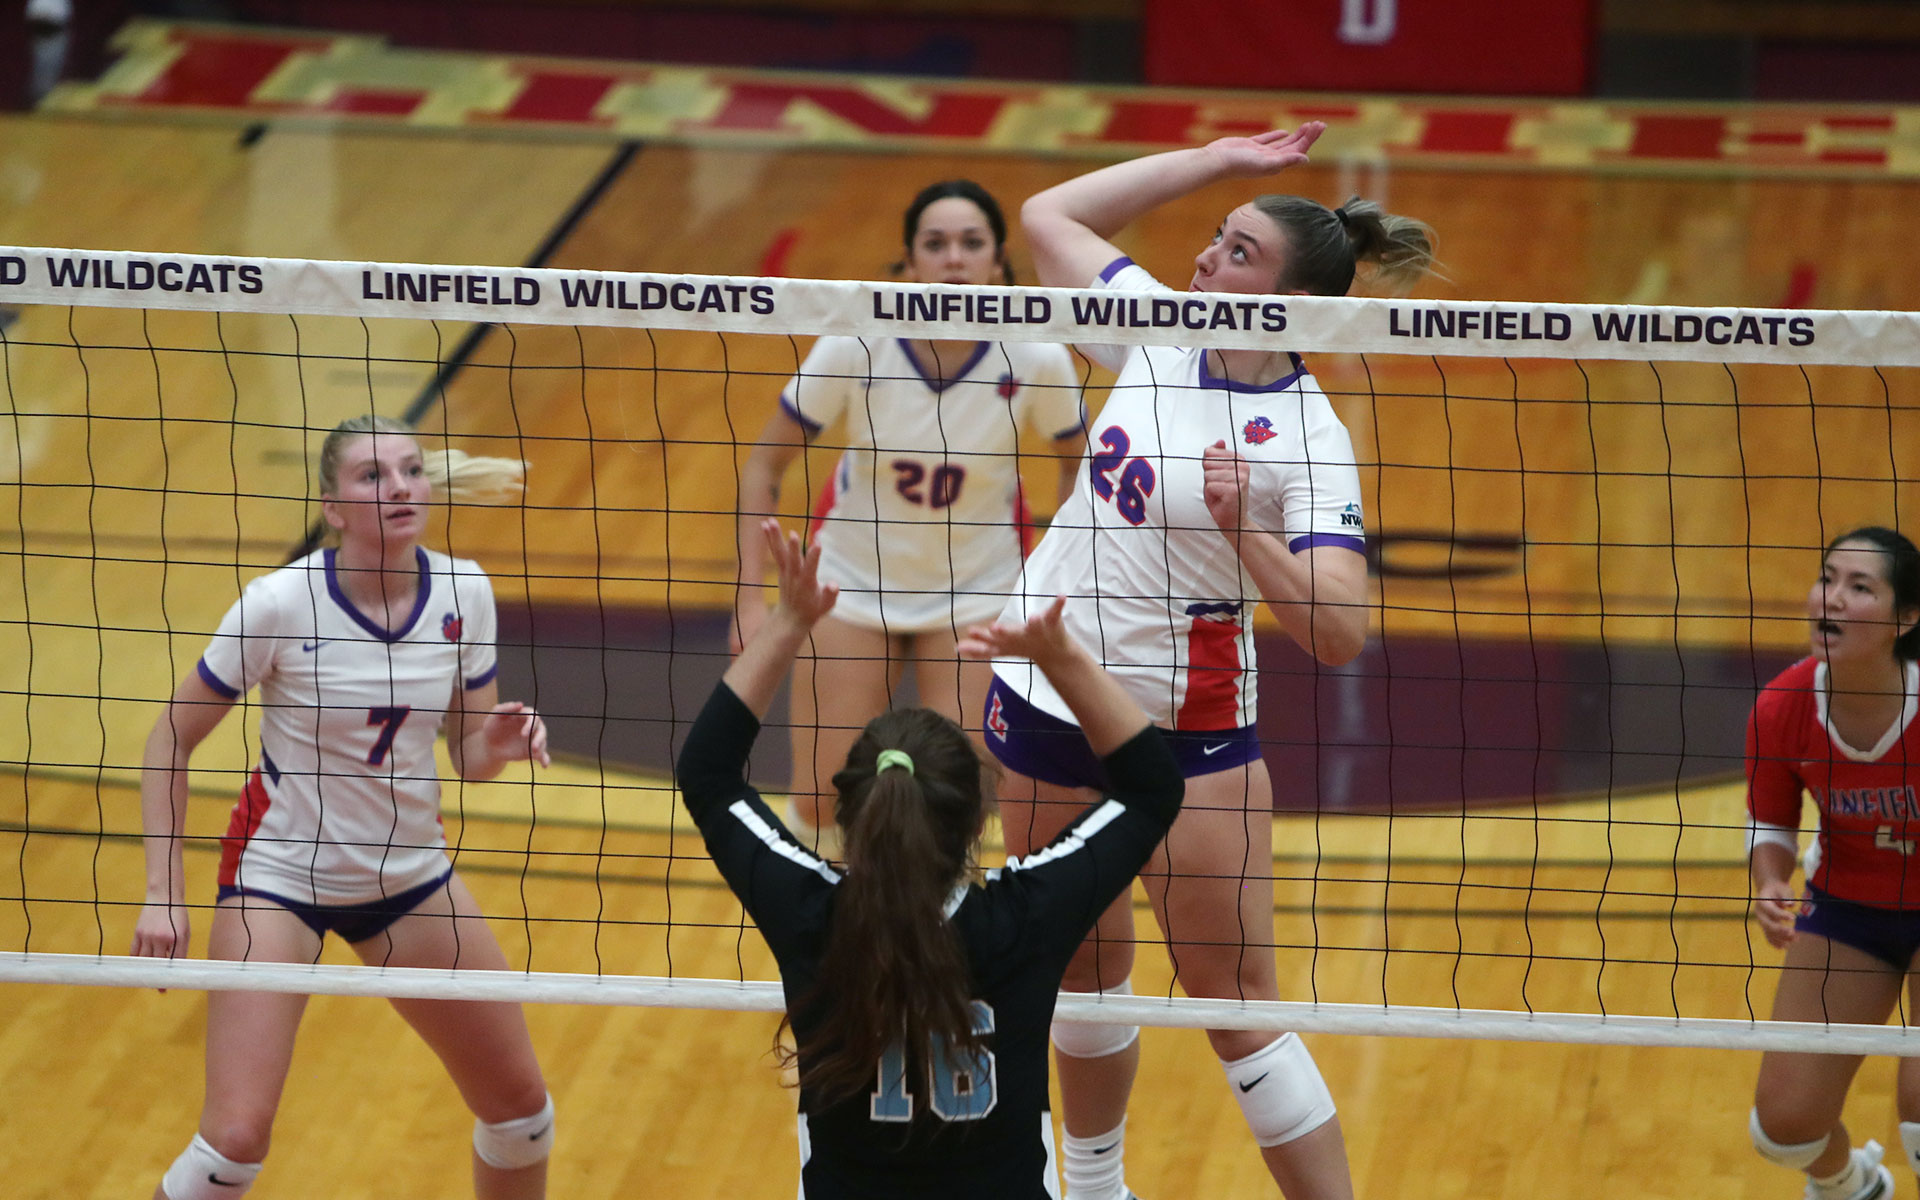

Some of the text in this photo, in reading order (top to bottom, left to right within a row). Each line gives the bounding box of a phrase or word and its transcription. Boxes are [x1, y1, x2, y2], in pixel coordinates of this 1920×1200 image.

[46, 256, 263, 294] WILDCATS
[362, 270, 775, 315] LINFIELD WILDCATS
[873, 291, 1287, 333] LINFIELD WILDCATS
[1389, 308, 1816, 347] LINFIELD WILDCATS
[892, 459, 965, 509] 20
[1090, 425, 1156, 526] 26
[366, 704, 411, 768] 7
[870, 999, 997, 1122] 16
